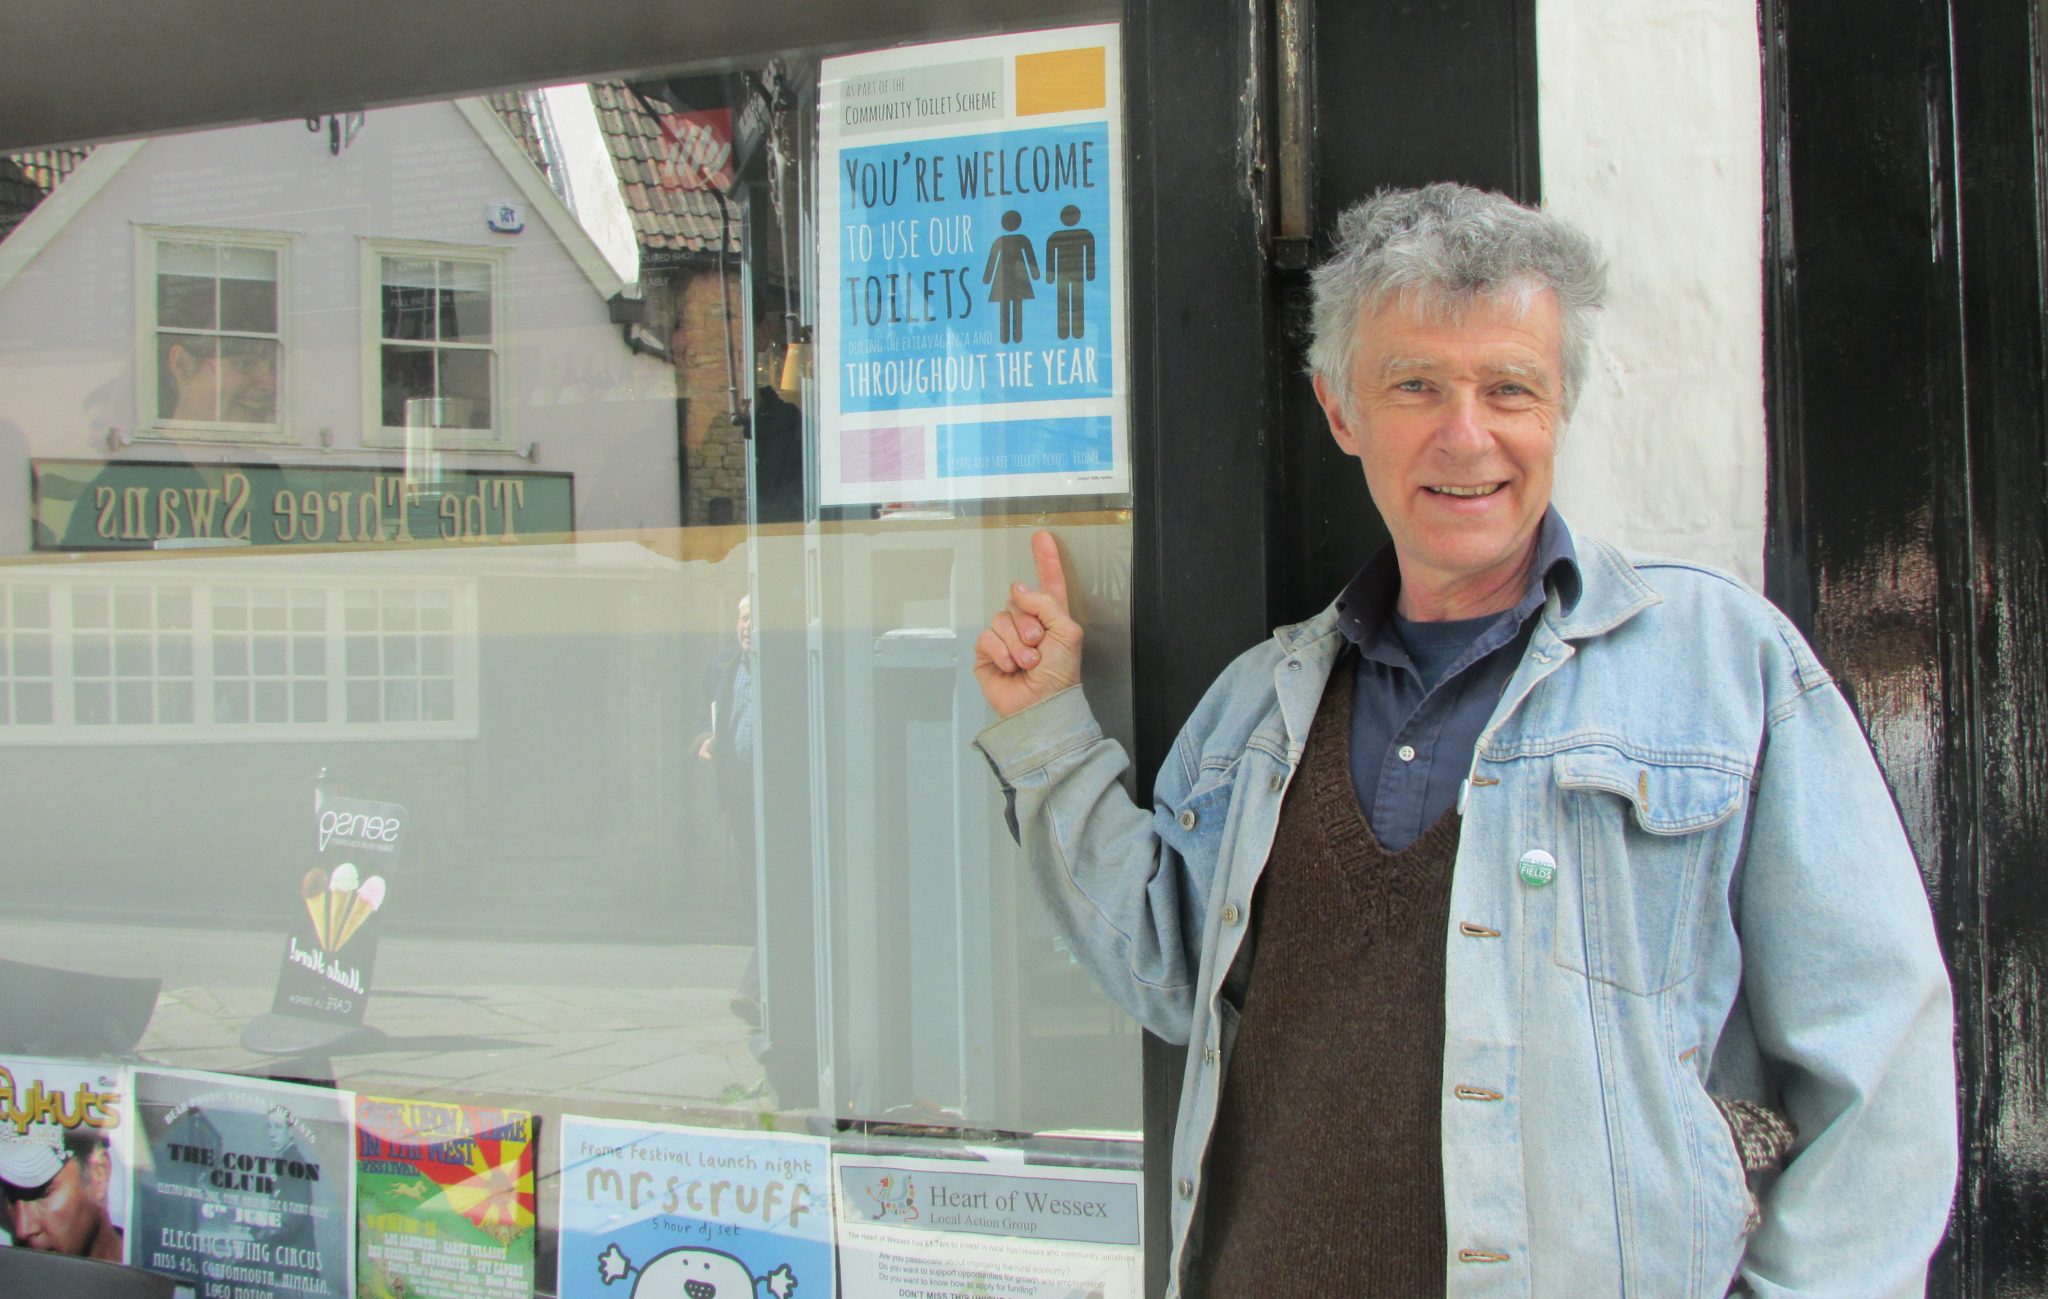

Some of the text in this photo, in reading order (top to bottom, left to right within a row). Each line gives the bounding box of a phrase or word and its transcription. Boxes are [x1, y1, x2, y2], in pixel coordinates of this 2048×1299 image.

[857, 80, 876, 97] PART
[879, 79, 889, 94] OF
[893, 77, 905, 92] THE
[845, 91, 997, 126] COMMUNITY TOILET SCHEME
[845, 141, 1095, 210] YOU'RE WELCOME
[846, 215, 974, 262] TO USE OUR
[846, 266, 973, 327] TOILETS
[973, 331, 993, 345] AND
[846, 347, 1098, 398] THROUGHOUT THE YEAR
[1521, 866, 1552, 880] FIELDS
[479, 1111, 528, 1143] TIME
[167, 1143, 321, 1182] THE COTTON
[427, 1137, 477, 1167] WEST
[210, 1168, 274, 1194] CLUB
[765, 1157, 812, 1181] night
[930, 1185, 1109, 1219] Heart of Wessex
[233, 1207, 283, 1228] JUNE
[652, 1217, 741, 1241] 5 hour dj set
[930, 1212, 1038, 1233] Local Action Group
[161, 1227, 323, 1272] ELECTRIC SWING CIRCUS
[847, 1231, 859, 1240] The
[861, 1233, 878, 1242] Heart
[959, 1242, 980, 1251] invest
[989, 1243, 1005, 1252] rural
[1046, 1248, 1059, 1257] and
[1060, 1250, 1099, 1262] community
[153, 1252, 177, 1270] MISS
[879, 1252, 1071, 1277] Are you passionate about improving the rural economy?
[879, 1262, 888, 1271] Do
[890, 1265, 902, 1274] you
[903, 1265, 919, 1275] want
[920, 1267, 928, 1276] to
[929, 1268, 957, 1279] support
[957, 1270, 1003, 1281] opportunities
[1004, 1273, 1014, 1282] for
[1015, 1274, 1040, 1285] growth
[1041, 1277, 1055, 1286] and
[879, 1272, 1038, 1296] Do you want to know how to apply for funding?
[205, 1281, 231, 1299] LOCO
[899, 1288, 925, 1299] DON'T
[926, 1290, 948, 1299] MISS
